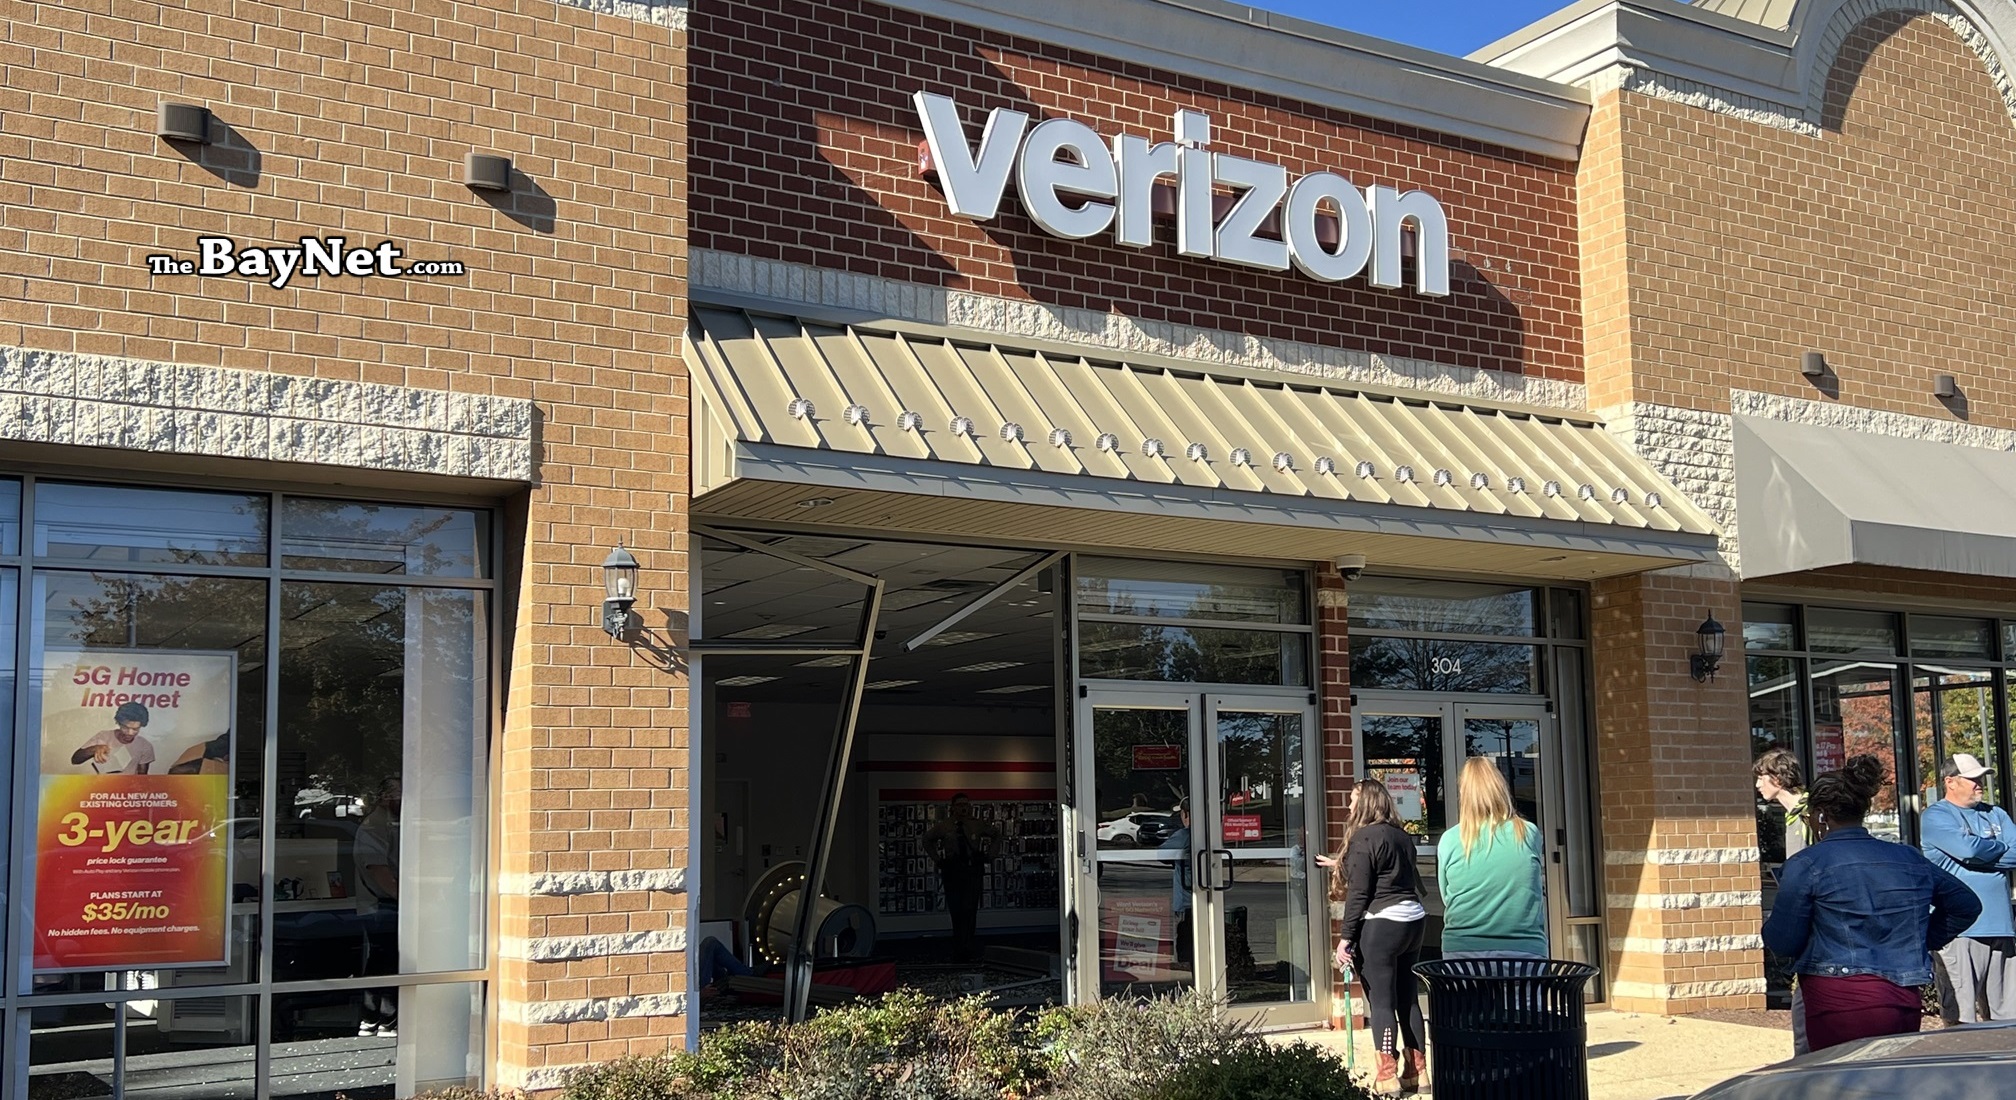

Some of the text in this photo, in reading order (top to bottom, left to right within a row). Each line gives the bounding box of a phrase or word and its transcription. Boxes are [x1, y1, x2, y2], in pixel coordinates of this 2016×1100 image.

[912, 90, 1450, 297] verizon
[1431, 657, 1462, 674] 304
[72, 665, 191, 687] 5G Home
[80, 687, 181, 708] Internet
[57, 812, 199, 853] 3-year
[86, 857, 108, 866] price
[127, 856, 168, 865] guarantee
[90, 892, 120, 900] PLANS
[82, 902, 170, 923] $35/mo
[124, 926, 166, 935] equipment
[166, 925, 200, 934] charges.
[1118, 956, 1153, 972] Deal
